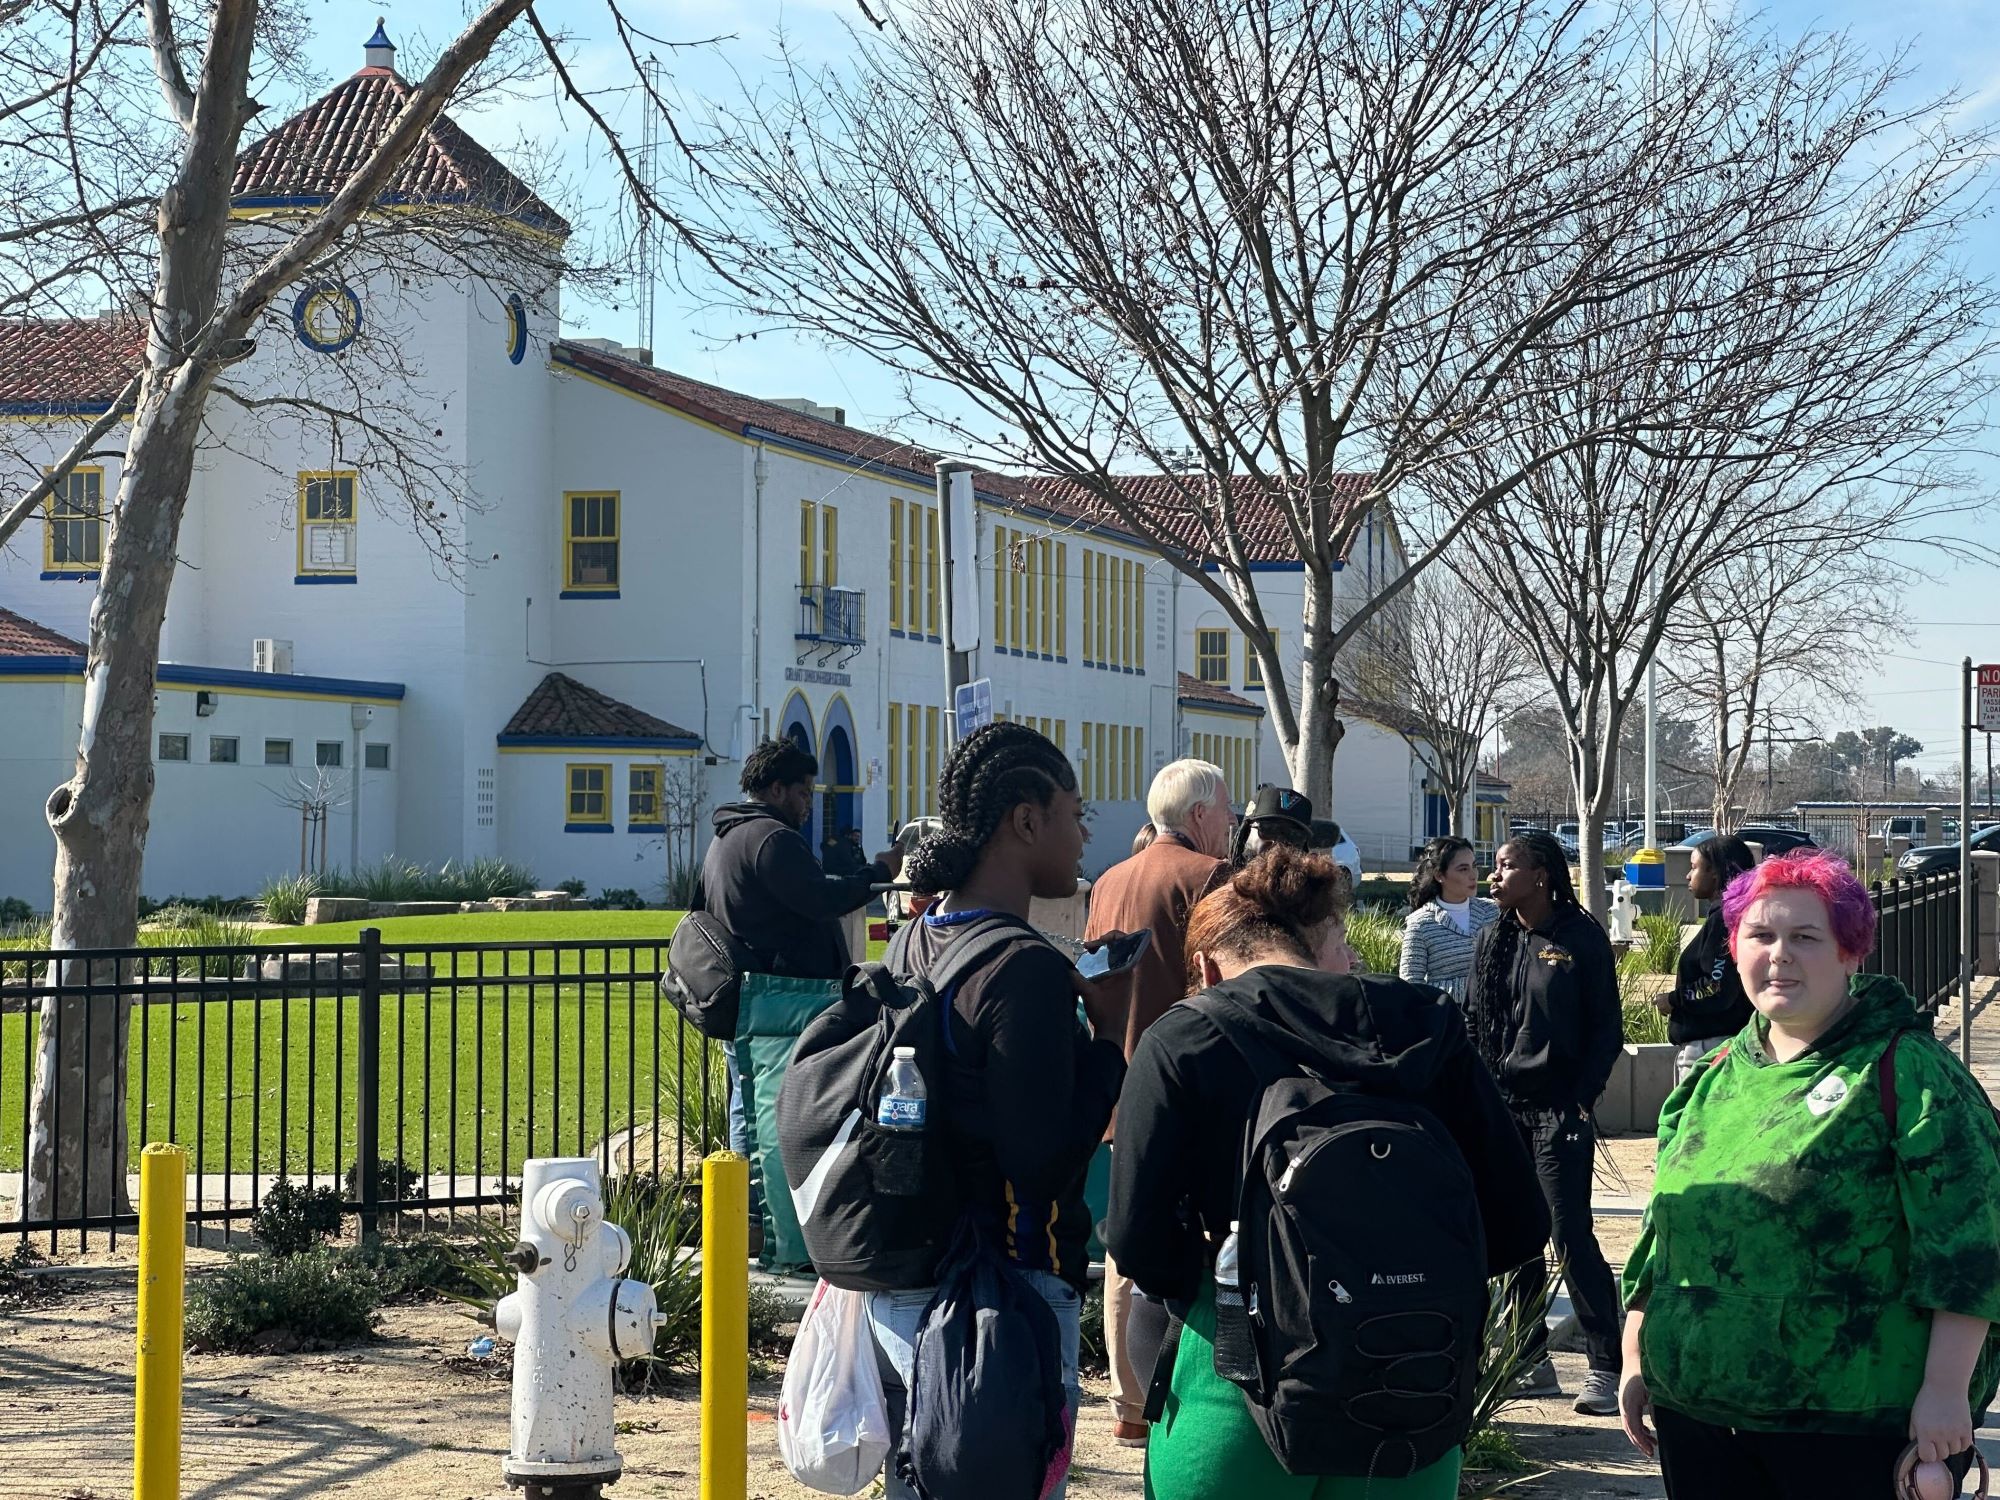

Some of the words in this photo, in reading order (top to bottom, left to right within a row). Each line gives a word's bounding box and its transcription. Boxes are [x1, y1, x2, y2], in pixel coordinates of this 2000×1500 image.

[1982, 669, 2000, 683] NO
[1982, 687, 2000, 698] PAR
[1386, 1273, 1424, 1284] EVEREST
